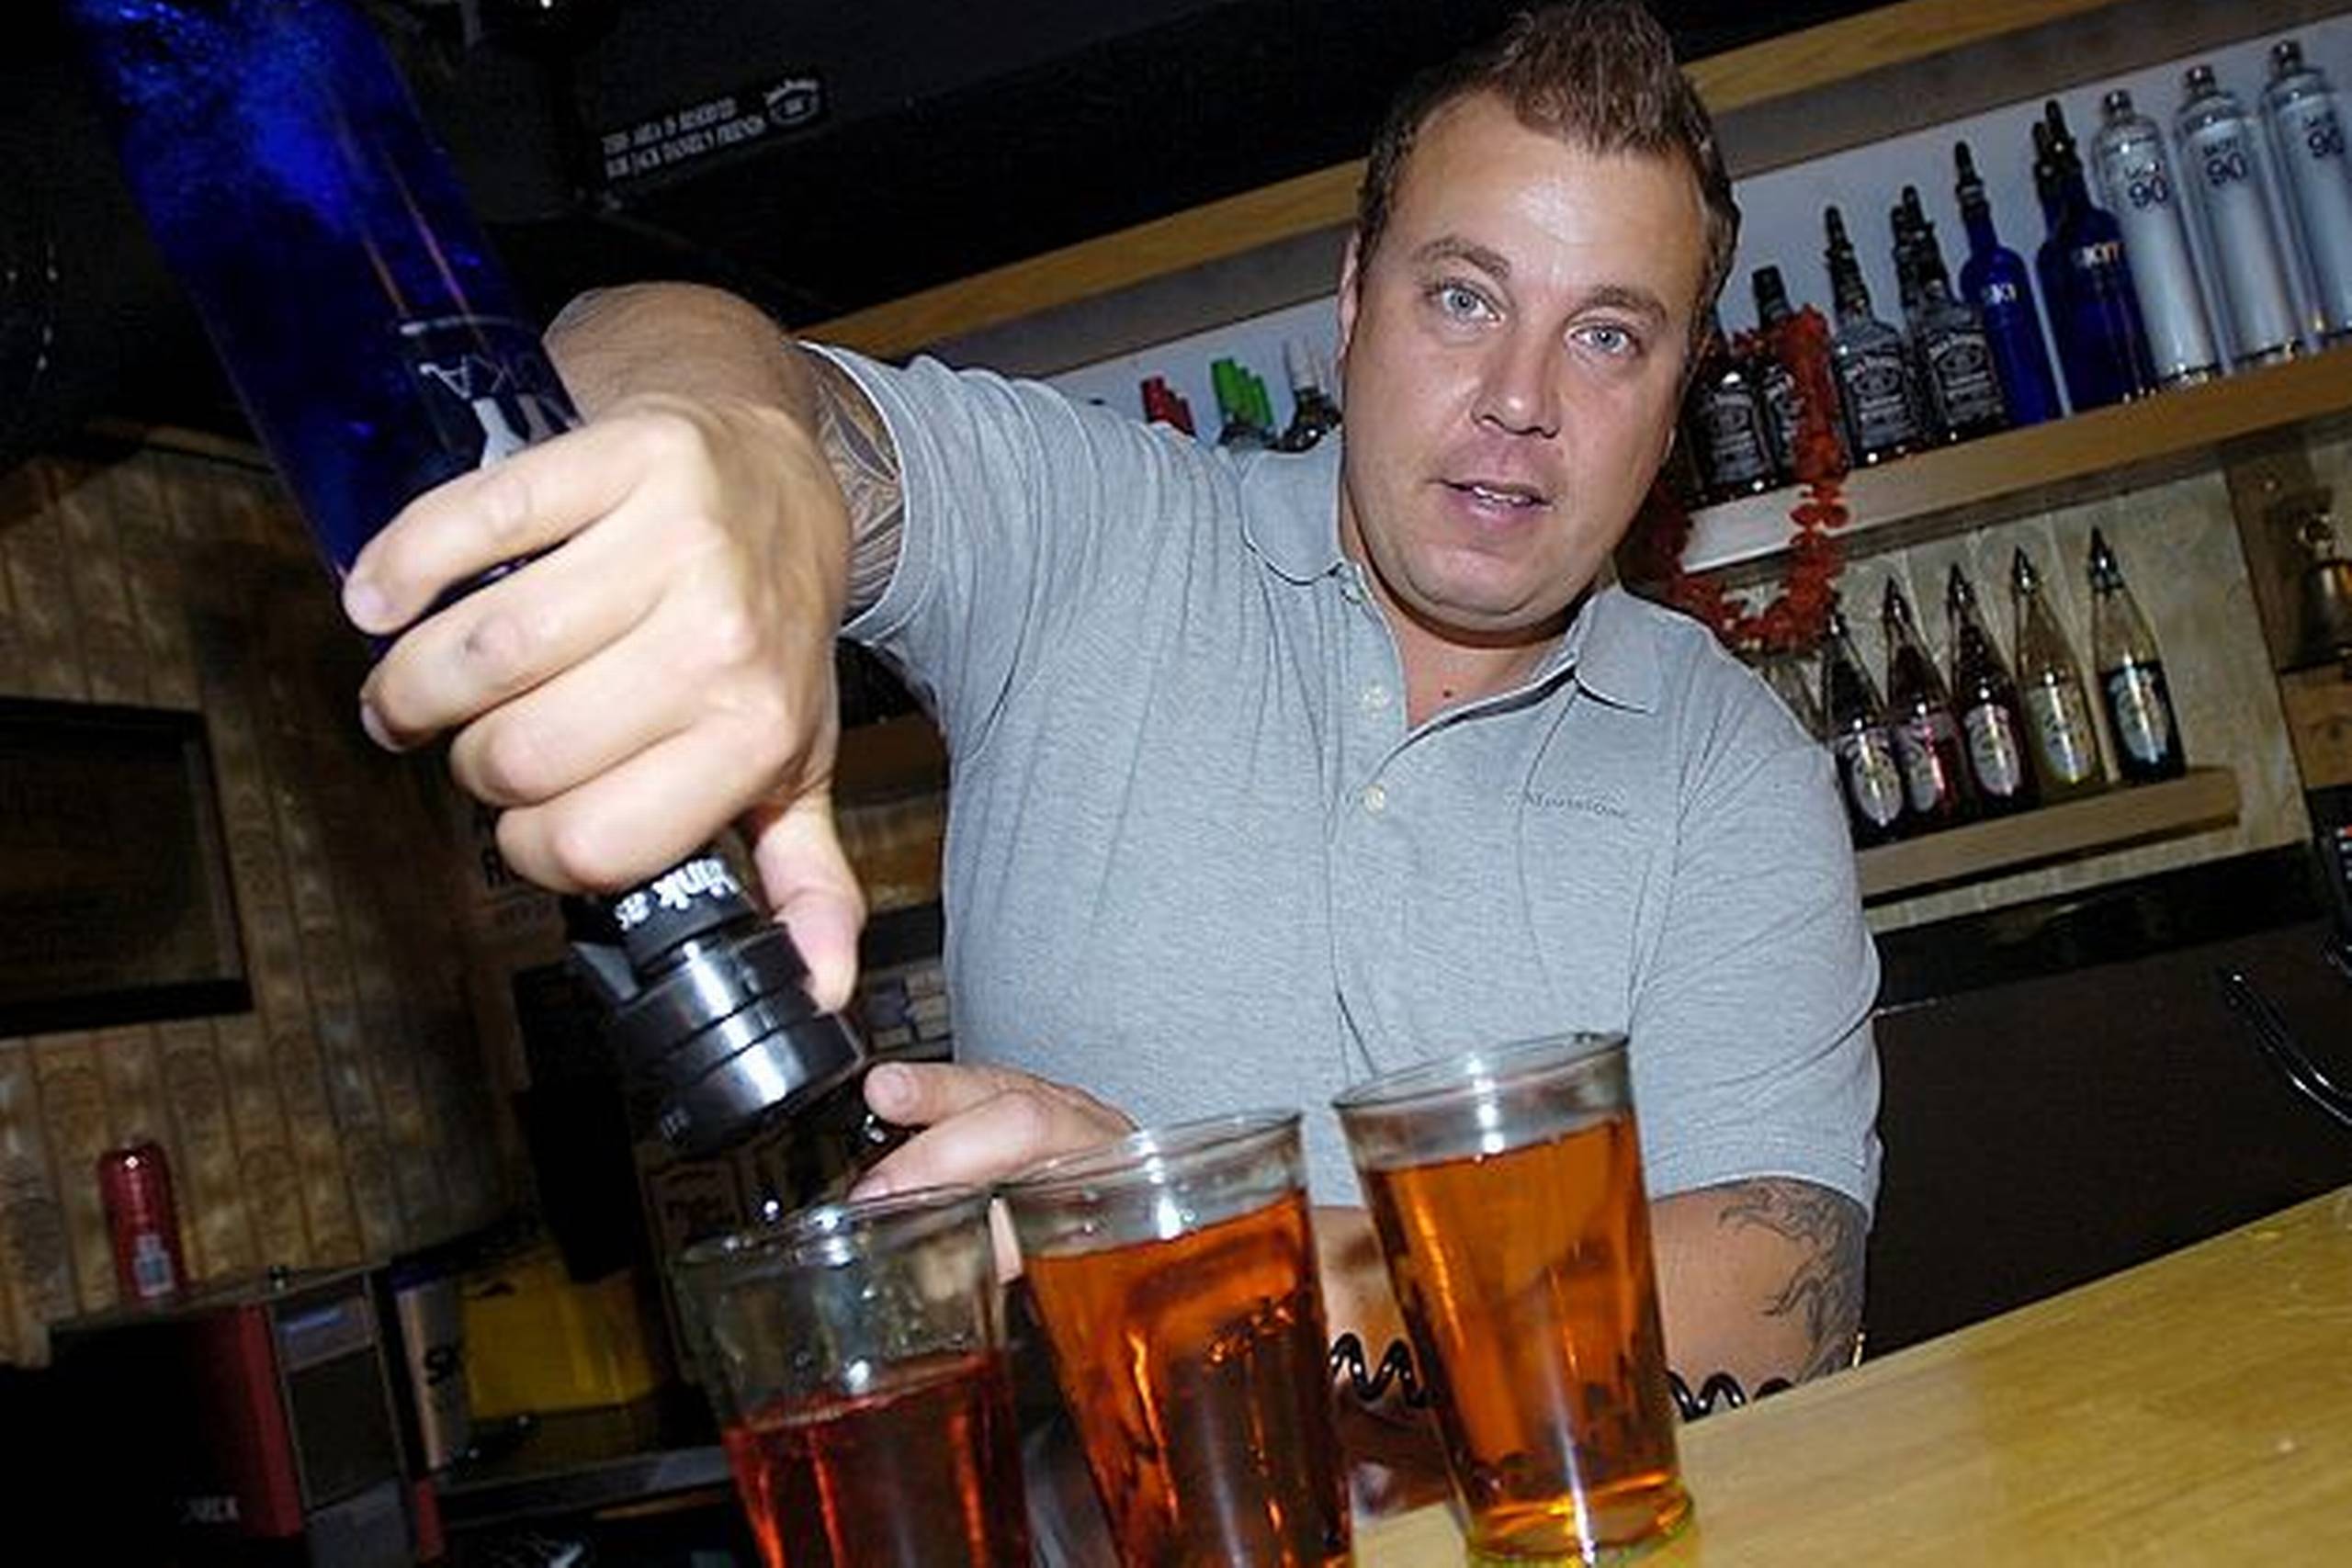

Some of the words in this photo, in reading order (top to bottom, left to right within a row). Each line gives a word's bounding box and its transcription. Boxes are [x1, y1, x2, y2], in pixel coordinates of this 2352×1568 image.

[2308, 125, 2345, 158] 90
[2207, 152, 2246, 186] 90
[2129, 175, 2168, 209] 90
